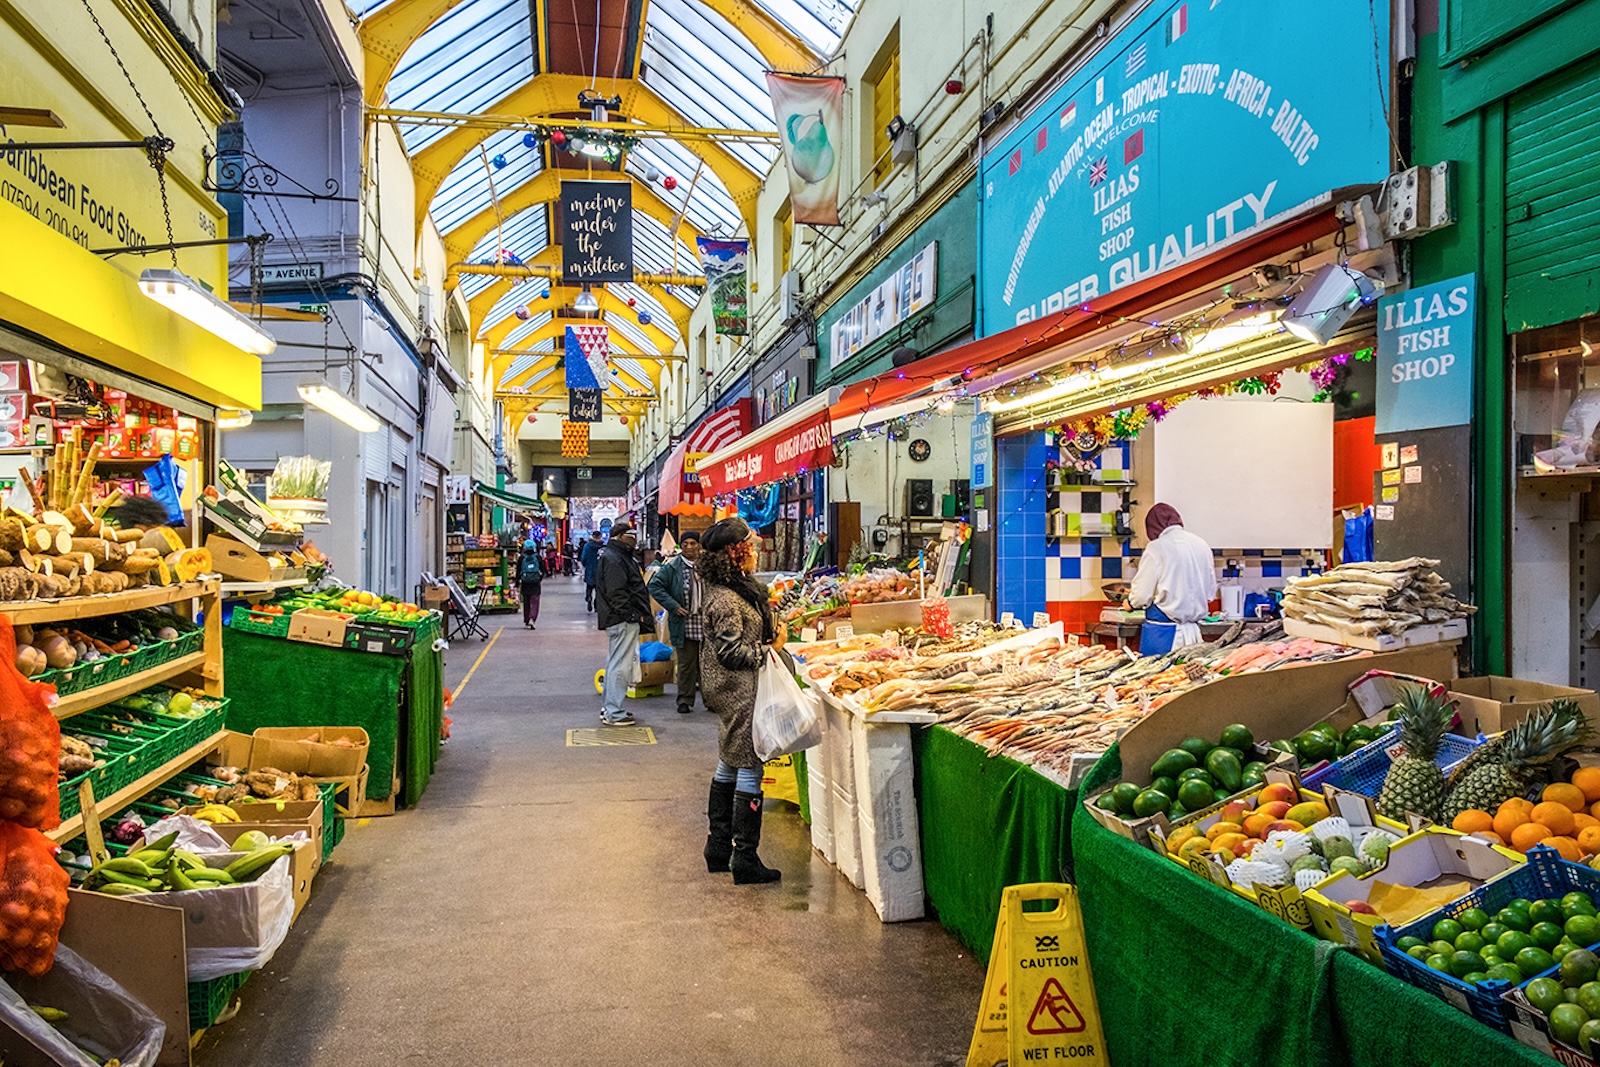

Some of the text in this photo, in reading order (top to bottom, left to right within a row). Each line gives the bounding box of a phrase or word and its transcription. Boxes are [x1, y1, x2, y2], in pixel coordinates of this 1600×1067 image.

[1076, 109, 1160, 179] ALL WELCOME
[1002, 196, 1046, 306] MEDITERRANEAN
[1048, 136, 1084, 199] ATLANTIC
[1083, 102, 1114, 149] OCEAN
[1122, 70, 1169, 117] TROPICAL
[1177, 63, 1220, 96] EXOTIC
[1223, 68, 1272, 119] AFRICA
[1271, 99, 1320, 167] BALTIC
[1093, 164, 1140, 216] ILIAS
[80, 183, 114, 235] Food
[570, 192, 626, 217] meet me
[570, 211, 617, 237] under
[1101, 202, 1132, 236] FISH
[575, 232, 602, 258] the
[1015, 180, 1278, 325] SUPER QUALITY
[1099, 226, 1135, 262] SHOP
[275, 268, 316, 278] AVENUE
[569, 255, 628, 278] mistletoe
[1383, 286, 1468, 331] ILIAS
[1396, 325, 1451, 355] FISH
[1391, 353, 1456, 384] SHOP
[971, 420, 991, 438] ILIAS
[972, 451, 988, 465] SHOP
[974, 438, 987, 451] FISH
[1020, 956, 1079, 969] CAUTION
[1023, 1045, 1096, 1061] WET FLOOR
